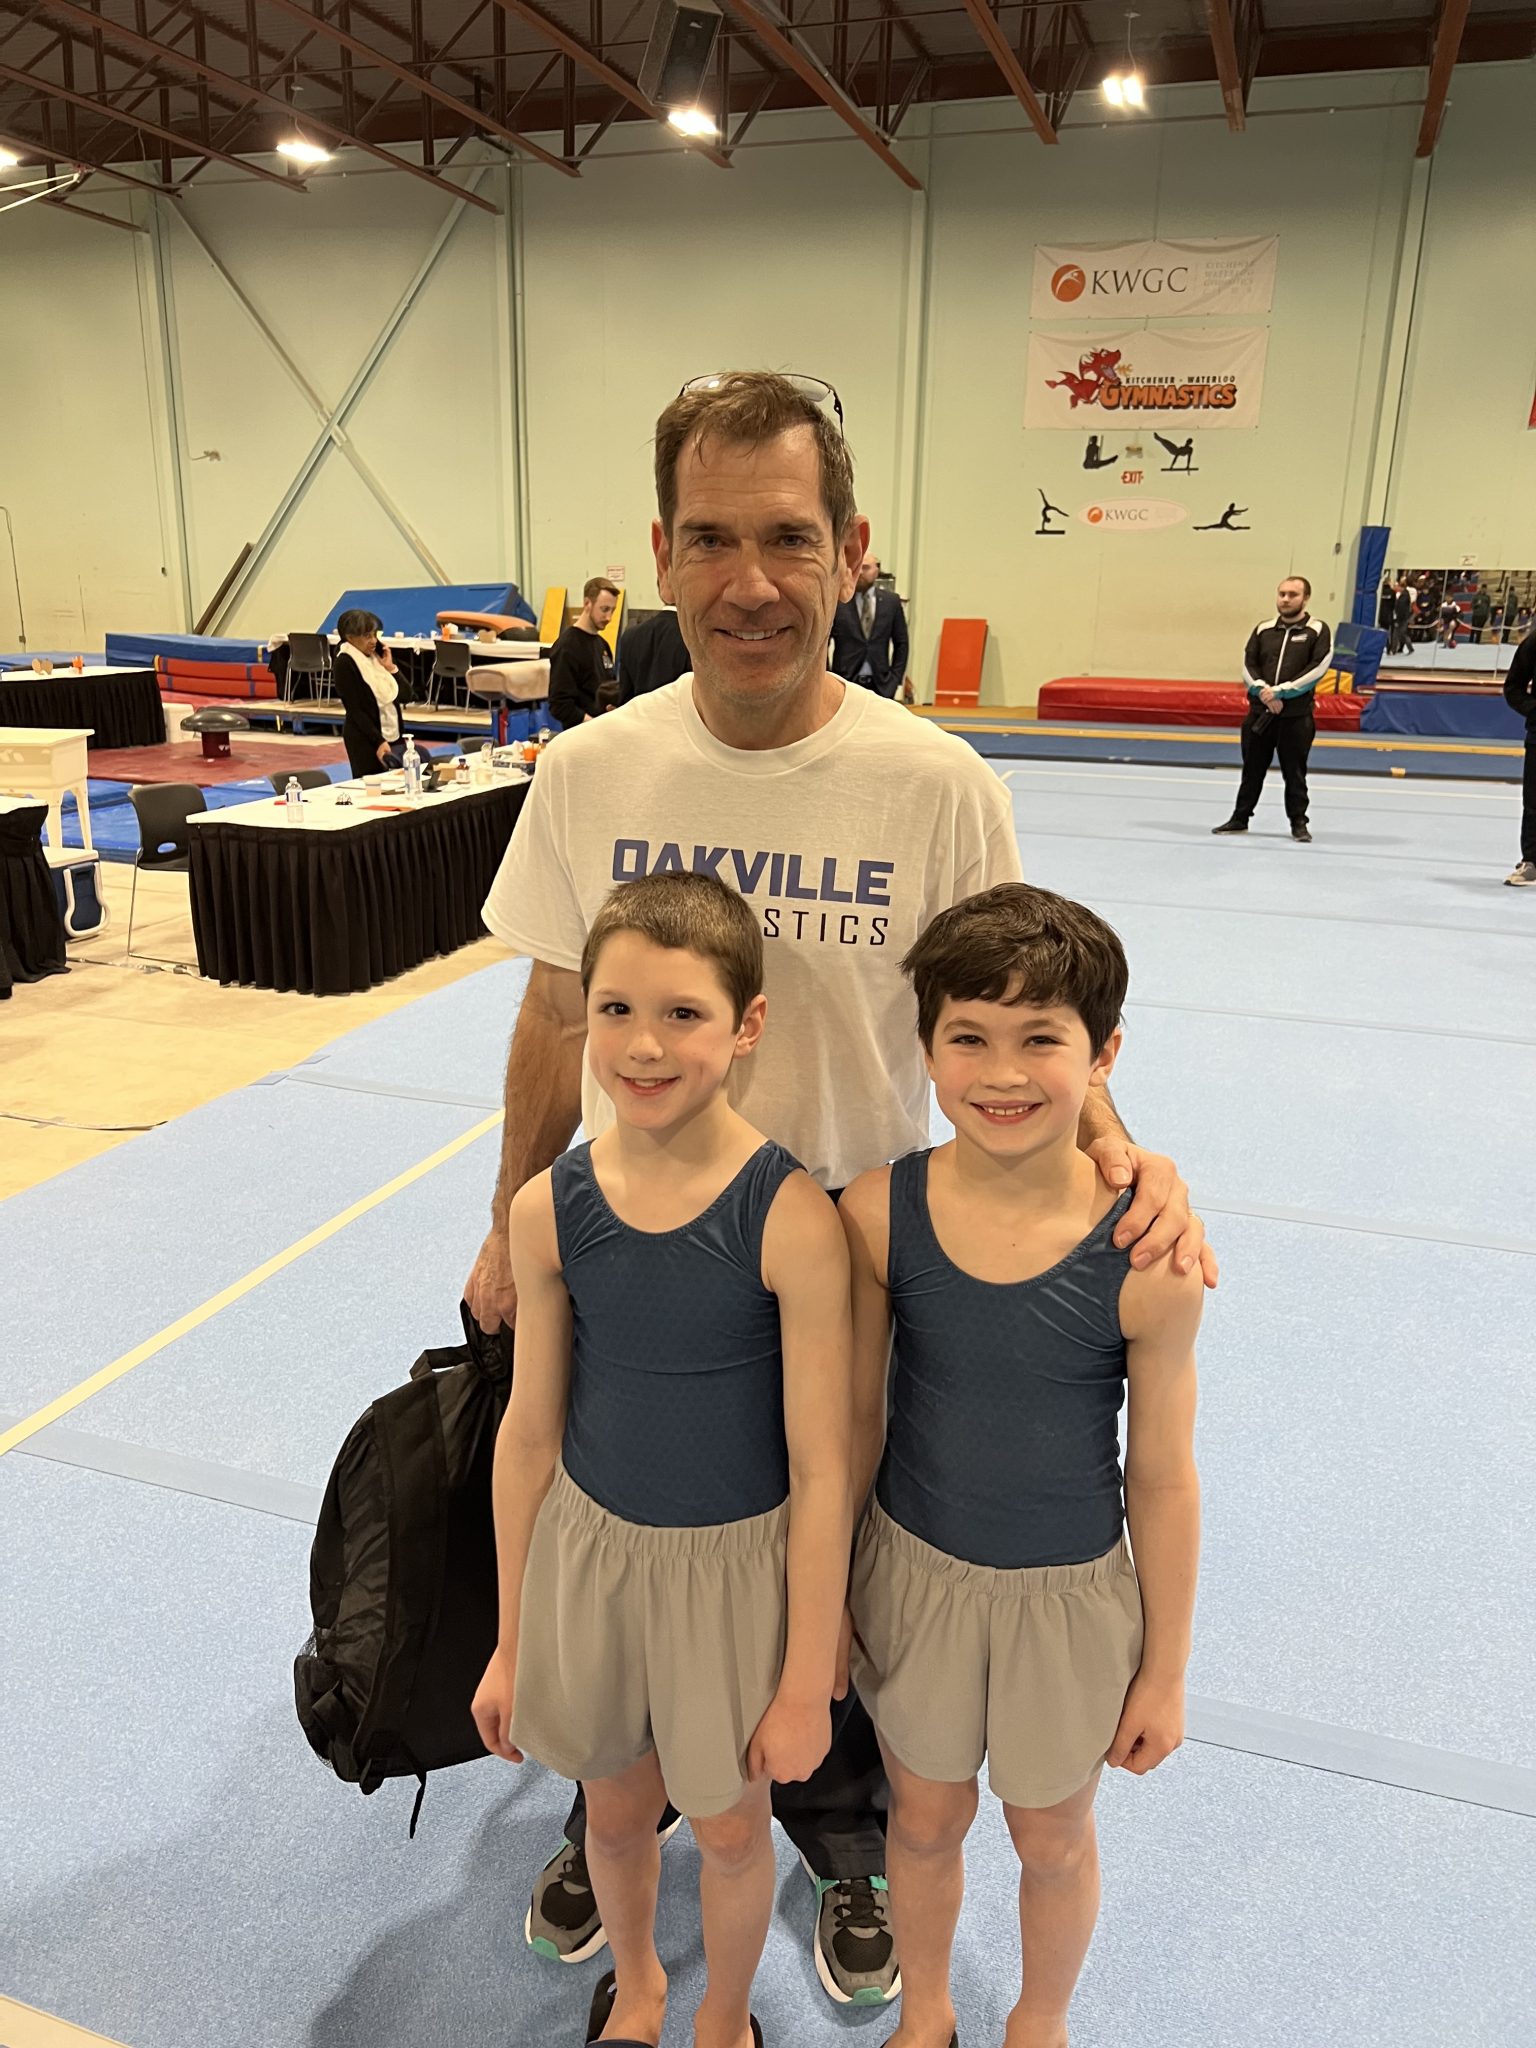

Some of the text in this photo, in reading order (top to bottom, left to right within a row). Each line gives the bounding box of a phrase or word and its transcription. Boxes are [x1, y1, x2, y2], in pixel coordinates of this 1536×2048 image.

[1092, 266, 1188, 295] KWGC
[1125, 376, 1175, 384] KITCHENER
[1187, 375, 1236, 384] WATERLOO
[1100, 381, 1238, 410] GYMNASTICS
[1122, 470, 1143, 484] EXIT
[1105, 508, 1149, 521] KWGC
[612, 838, 894, 907] OAKVILLE
[763, 908, 889, 946] STICS
